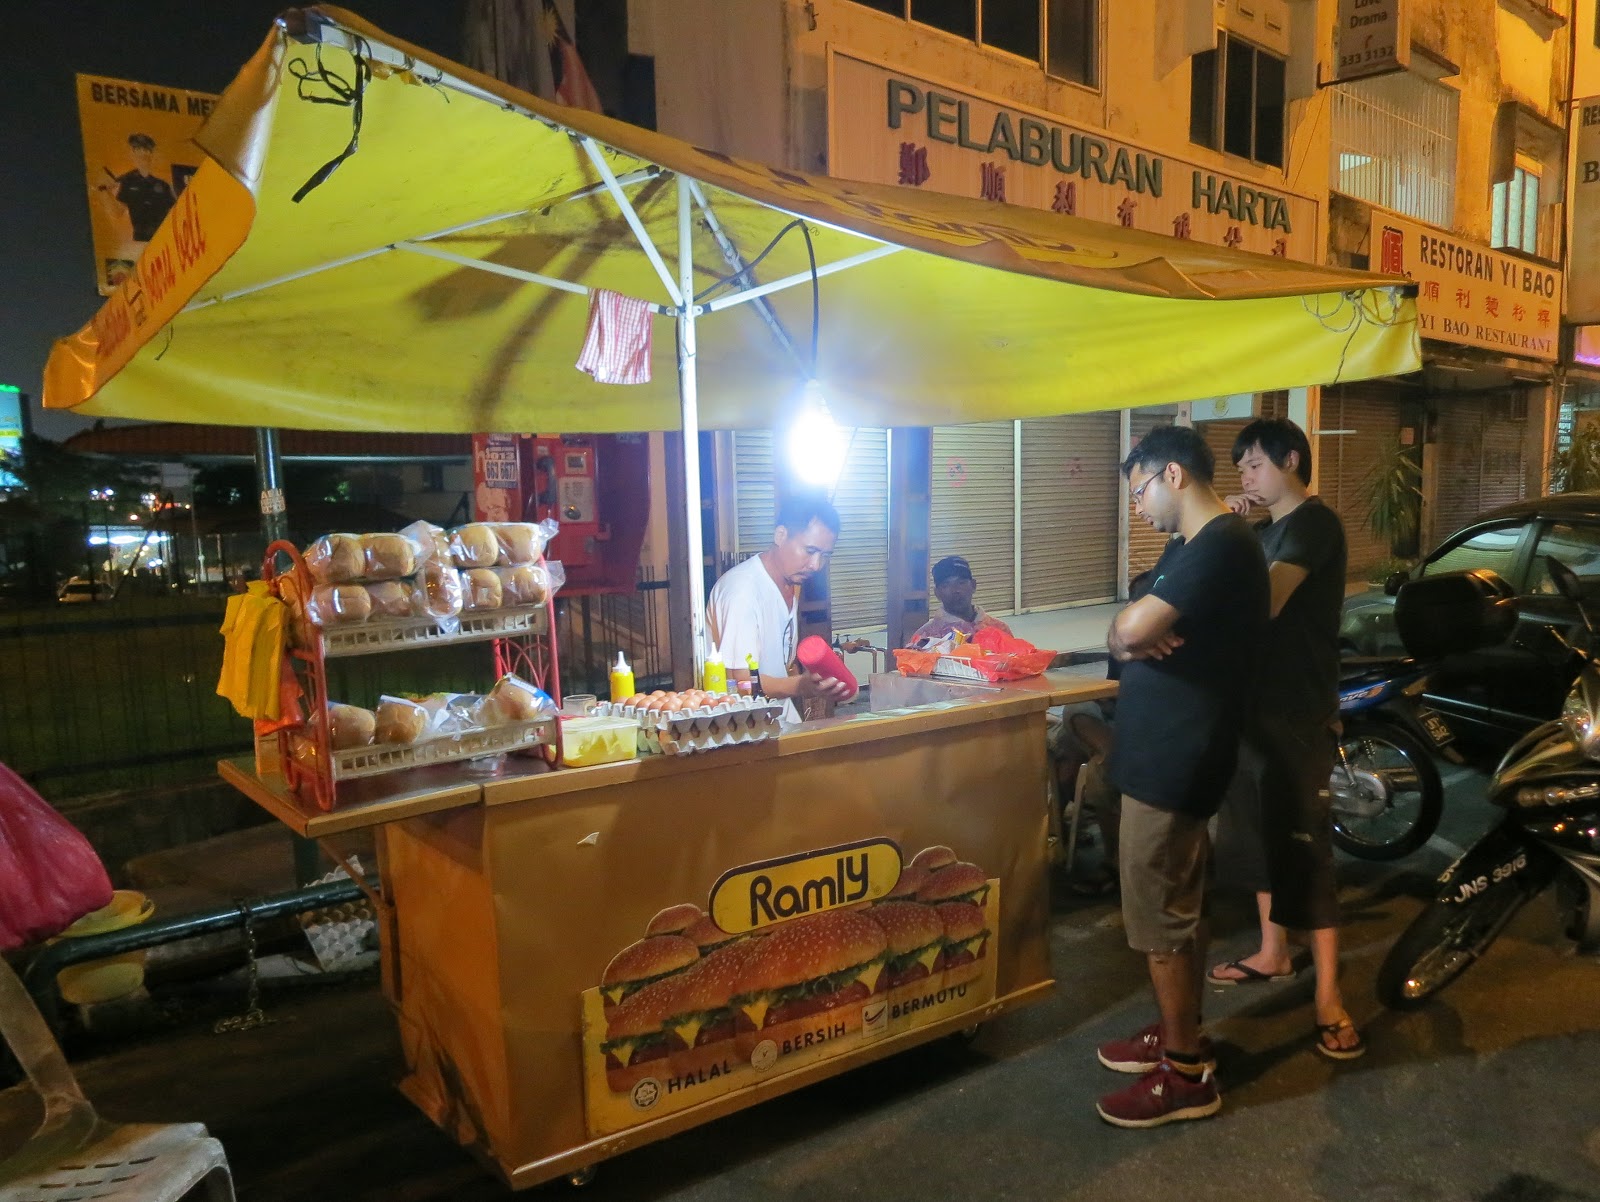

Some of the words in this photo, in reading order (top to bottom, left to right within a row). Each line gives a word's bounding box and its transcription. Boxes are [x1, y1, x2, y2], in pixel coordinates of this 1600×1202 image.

[1351, 11, 1387, 29] Drama
[91, 82, 180, 114] BERSAMA
[187, 97, 215, 117] ME
[887, 78, 1163, 198] PELABURAN
[1192, 171, 1292, 234] HARTA
[1420, 235, 1493, 282] RESTORAN
[1500, 260, 1517, 289] YI
[1522, 267, 1555, 298] BAO
[1420, 313, 1435, 330] YI
[1443, 318, 1470, 337] BAO
[1476, 325, 1552, 353] RESTAURANT
[750, 853, 868, 926] Ramly
[1454, 876, 1488, 902] JNS
[891, 983, 967, 1019] BERMUTU
[782, 1021, 847, 1055] BERSIH
[668, 1059, 732, 1094] HALAL
